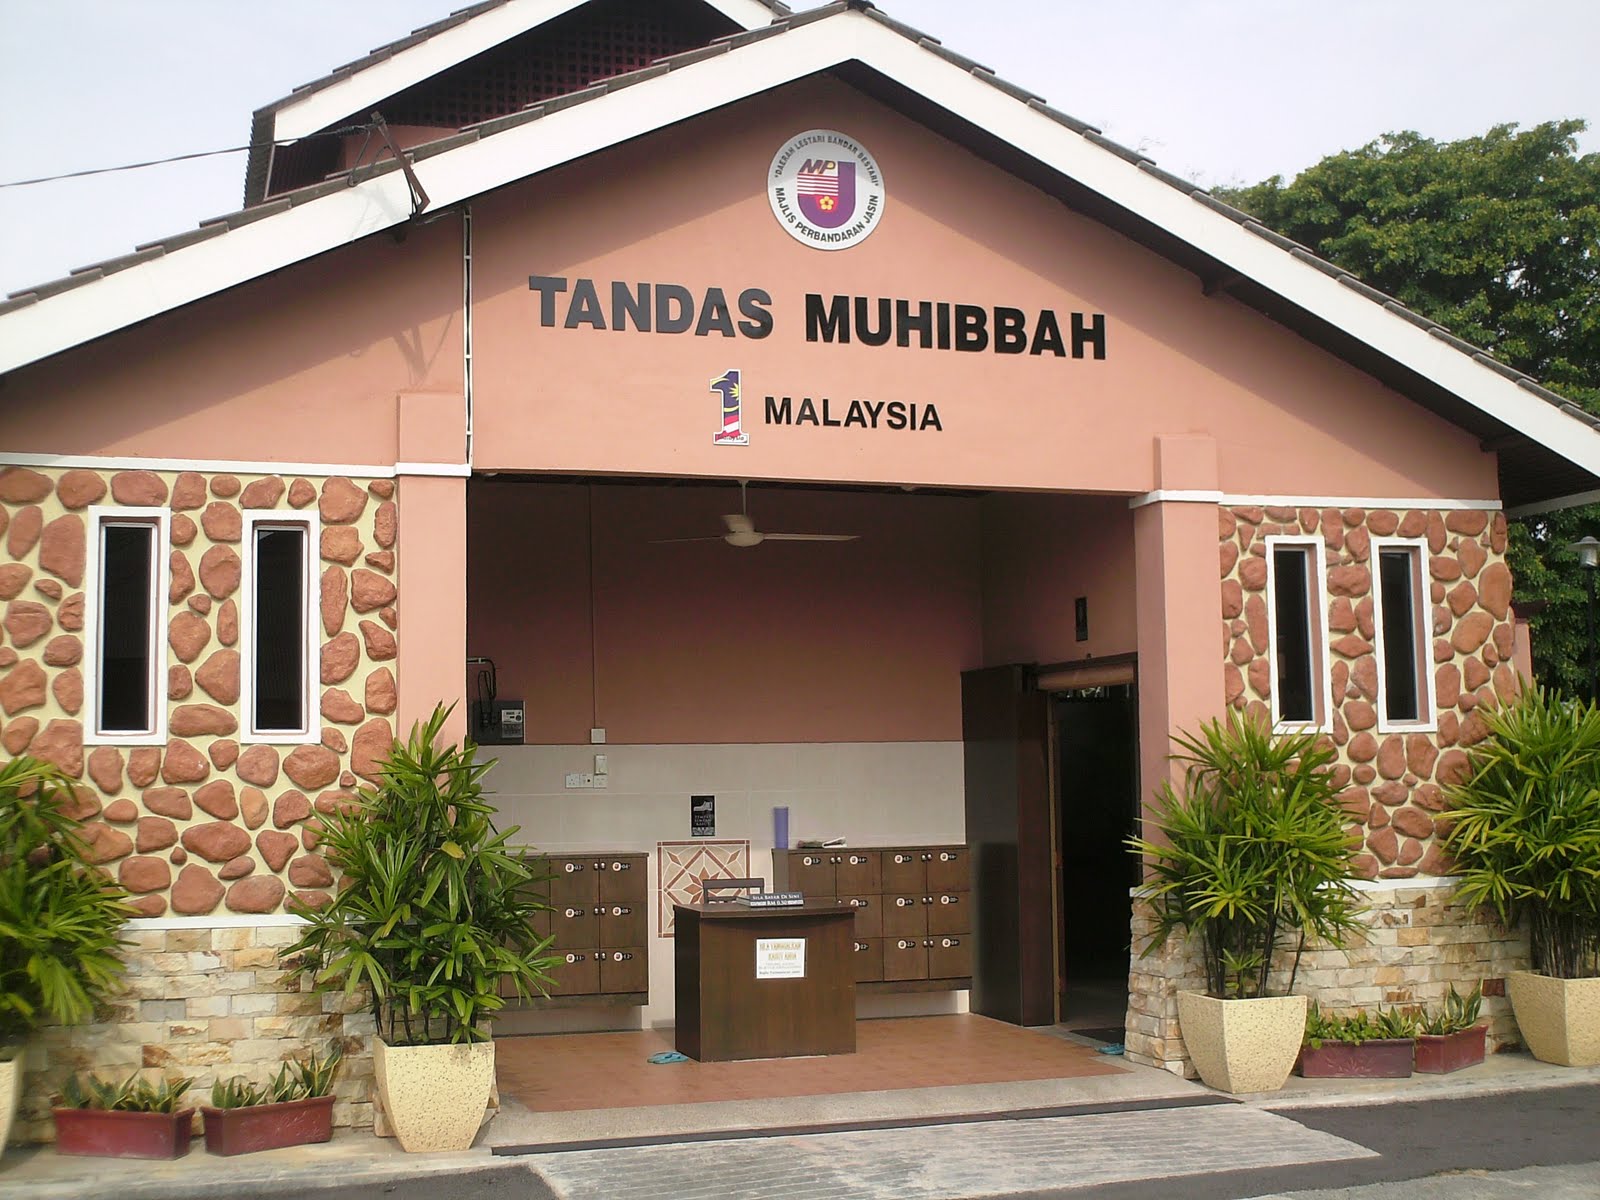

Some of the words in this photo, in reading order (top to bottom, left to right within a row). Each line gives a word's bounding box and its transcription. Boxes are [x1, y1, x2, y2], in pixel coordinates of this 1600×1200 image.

[796, 135, 825, 150] LESTARI
[775, 187, 797, 224] MAJLIS
[795, 221, 866, 243] PERBANDARAN
[865, 194, 879, 224] JASIN
[528, 275, 774, 339] TANDAS
[805, 293, 1107, 361] MUHIBBAH
[709, 369, 749, 446] 1
[764, 397, 943, 431] MALAYSIA
